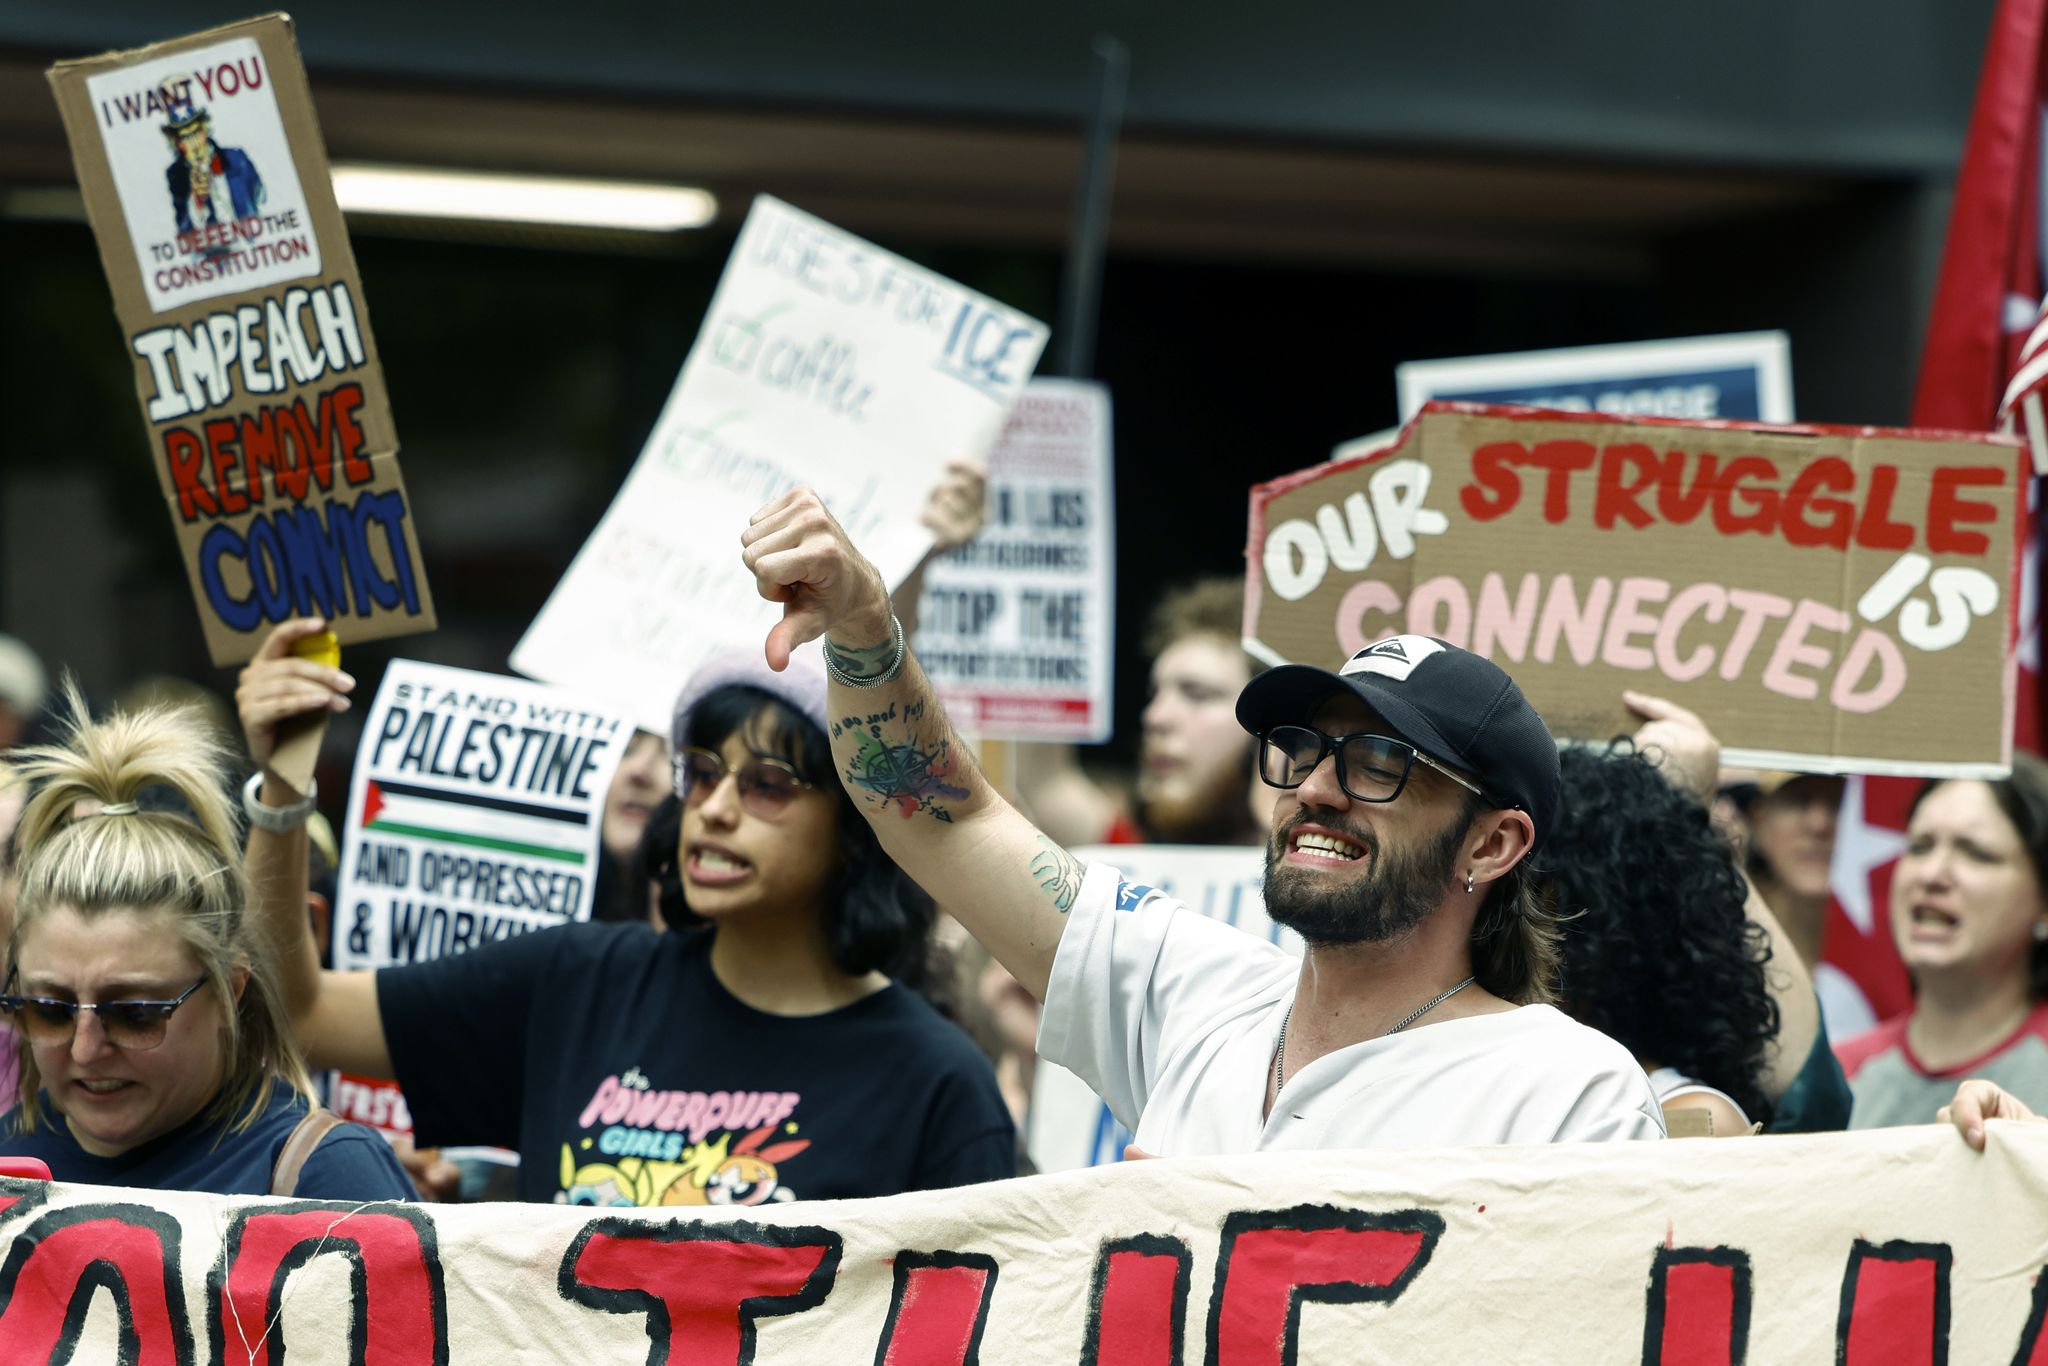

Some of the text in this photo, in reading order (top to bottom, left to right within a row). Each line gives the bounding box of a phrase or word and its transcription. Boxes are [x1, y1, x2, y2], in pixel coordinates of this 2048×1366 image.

[101, 56, 263, 129] I WANT YOU
[151, 210, 300, 263] TO DEFEND THE
[153, 236, 310, 291] CONSTITUTION
[134, 283, 366, 421] IMPEACH
[944, 303, 1034, 385] ICE
[163, 382, 375, 523] REMOVE
[1264, 439, 2006, 600] OUR STRUGGLE
[200, 490, 421, 632] CONVICT
[1018, 588, 1085, 641] THE
[1857, 553, 2000, 651] IS
[1336, 572, 1907, 714] CONNECTED
[395, 683, 621, 734] STAND WITH
[371, 706, 608, 800] PALESTINE
[353, 842, 583, 917] AND OPPRESSED
[348, 901, 374, 954] &
[578, 1074, 800, 1144] POWERPUFF
[598, 1125, 685, 1161] GIRLS
